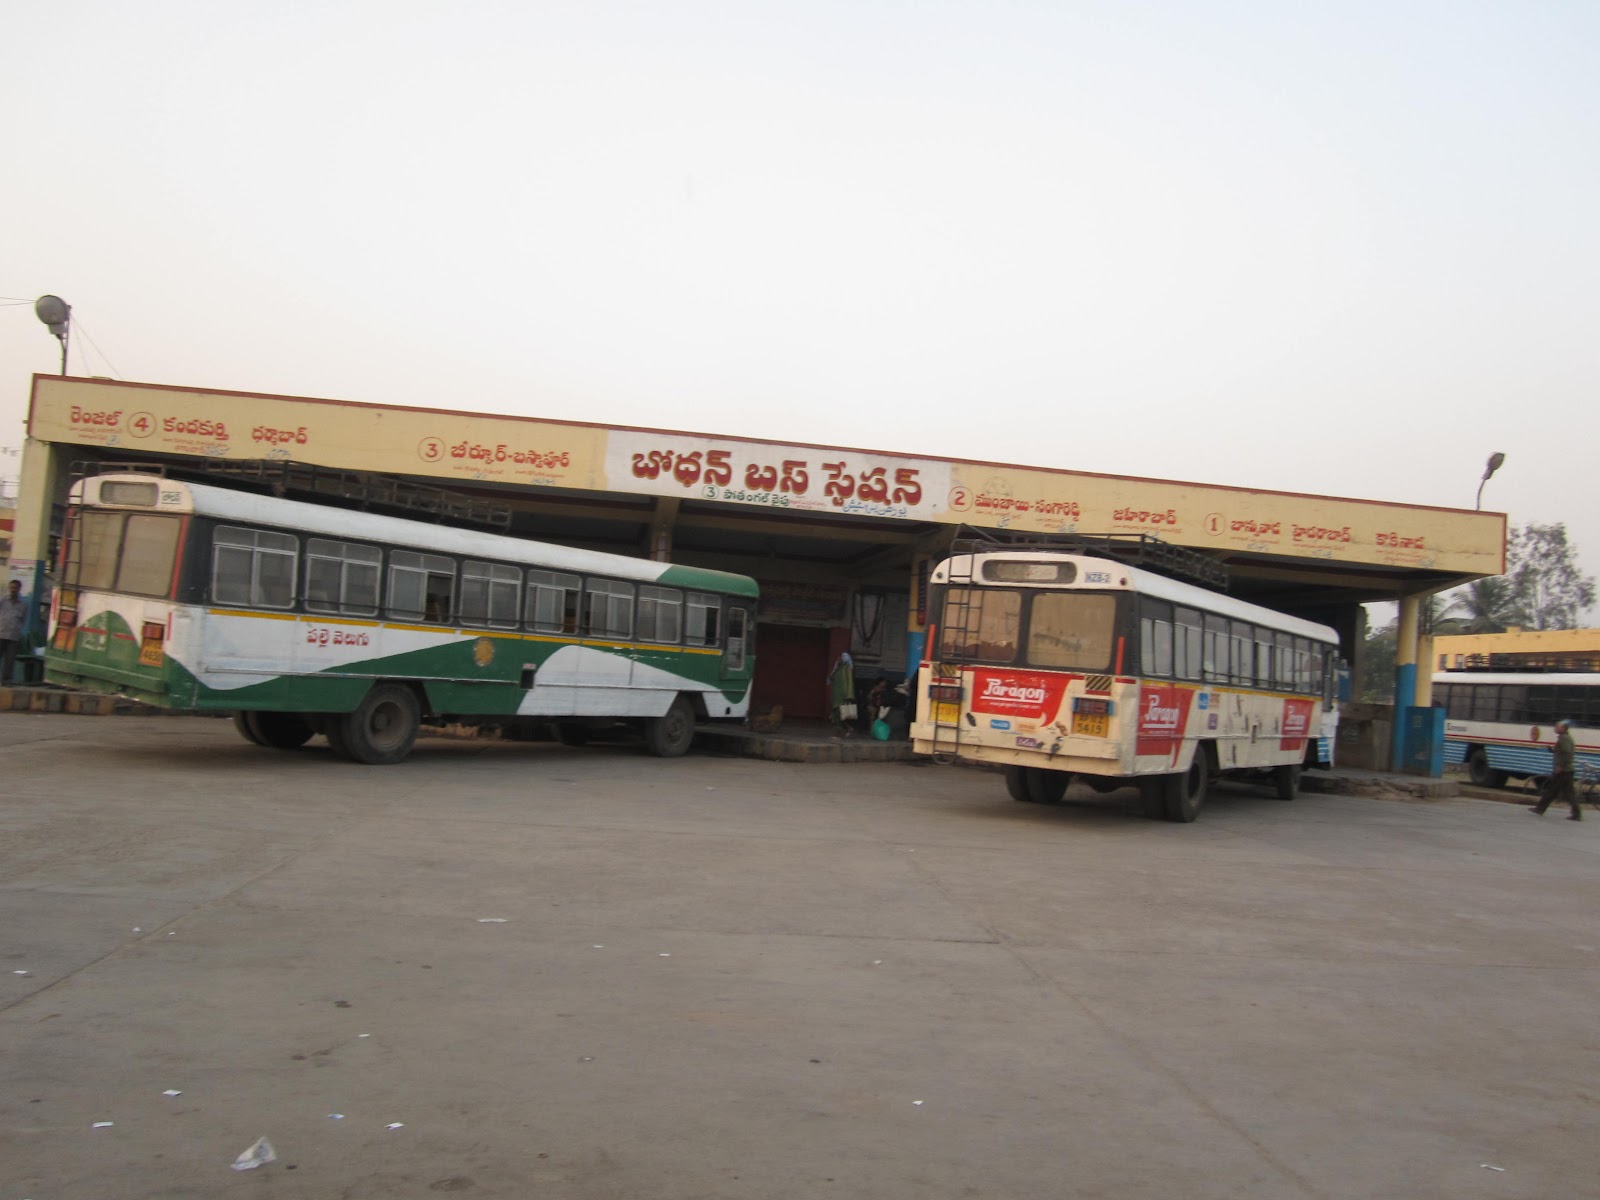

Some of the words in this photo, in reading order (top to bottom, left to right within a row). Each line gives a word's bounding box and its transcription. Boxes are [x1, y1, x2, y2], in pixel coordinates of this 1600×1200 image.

[134, 416, 149, 432] 4
[425, 443, 438, 458] 3
[631, 449, 732, 488] బోధన్
[744, 460, 808, 494] బస్
[821, 461, 922, 507] స్టేషన్
[705, 485, 716, 498] 3
[954, 491, 966, 506] 2
[983, 678, 1045, 702] Paragon
